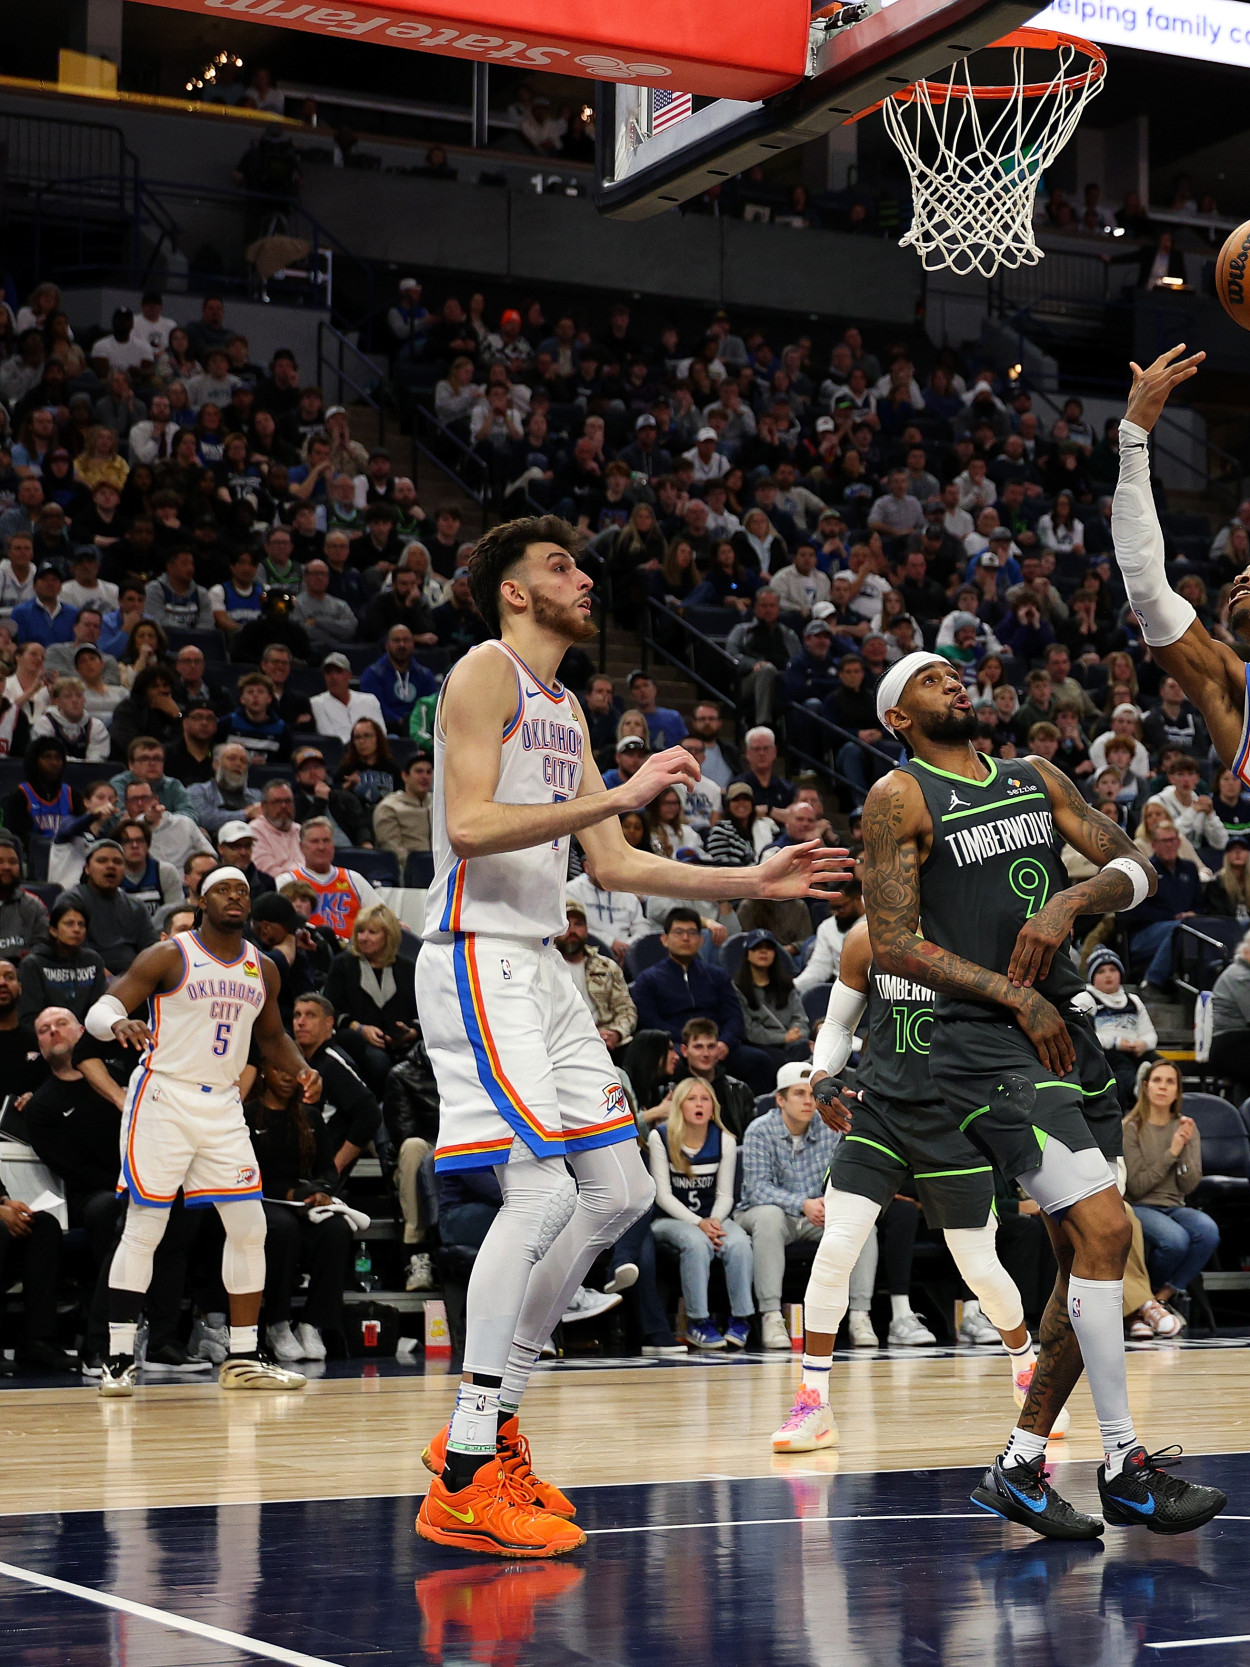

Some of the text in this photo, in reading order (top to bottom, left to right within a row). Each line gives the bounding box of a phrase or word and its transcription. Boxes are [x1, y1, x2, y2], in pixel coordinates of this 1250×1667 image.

[1052, 0, 1137, 31] elping
[1146, 6, 1221, 45] family
[522, 719, 584, 763] OKLAHO
[543, 754, 578, 791] CITY
[1006, 784, 1038, 796] sezzle
[1008, 857, 1049, 919] 9
[186, 979, 264, 1009] OKLAHOMA
[875, 974, 936, 1004] TIMBERW
[210, 1001, 243, 1022] CITY
[211, 1021, 233, 1058] 5
[687, 1190, 701, 1212] 5
